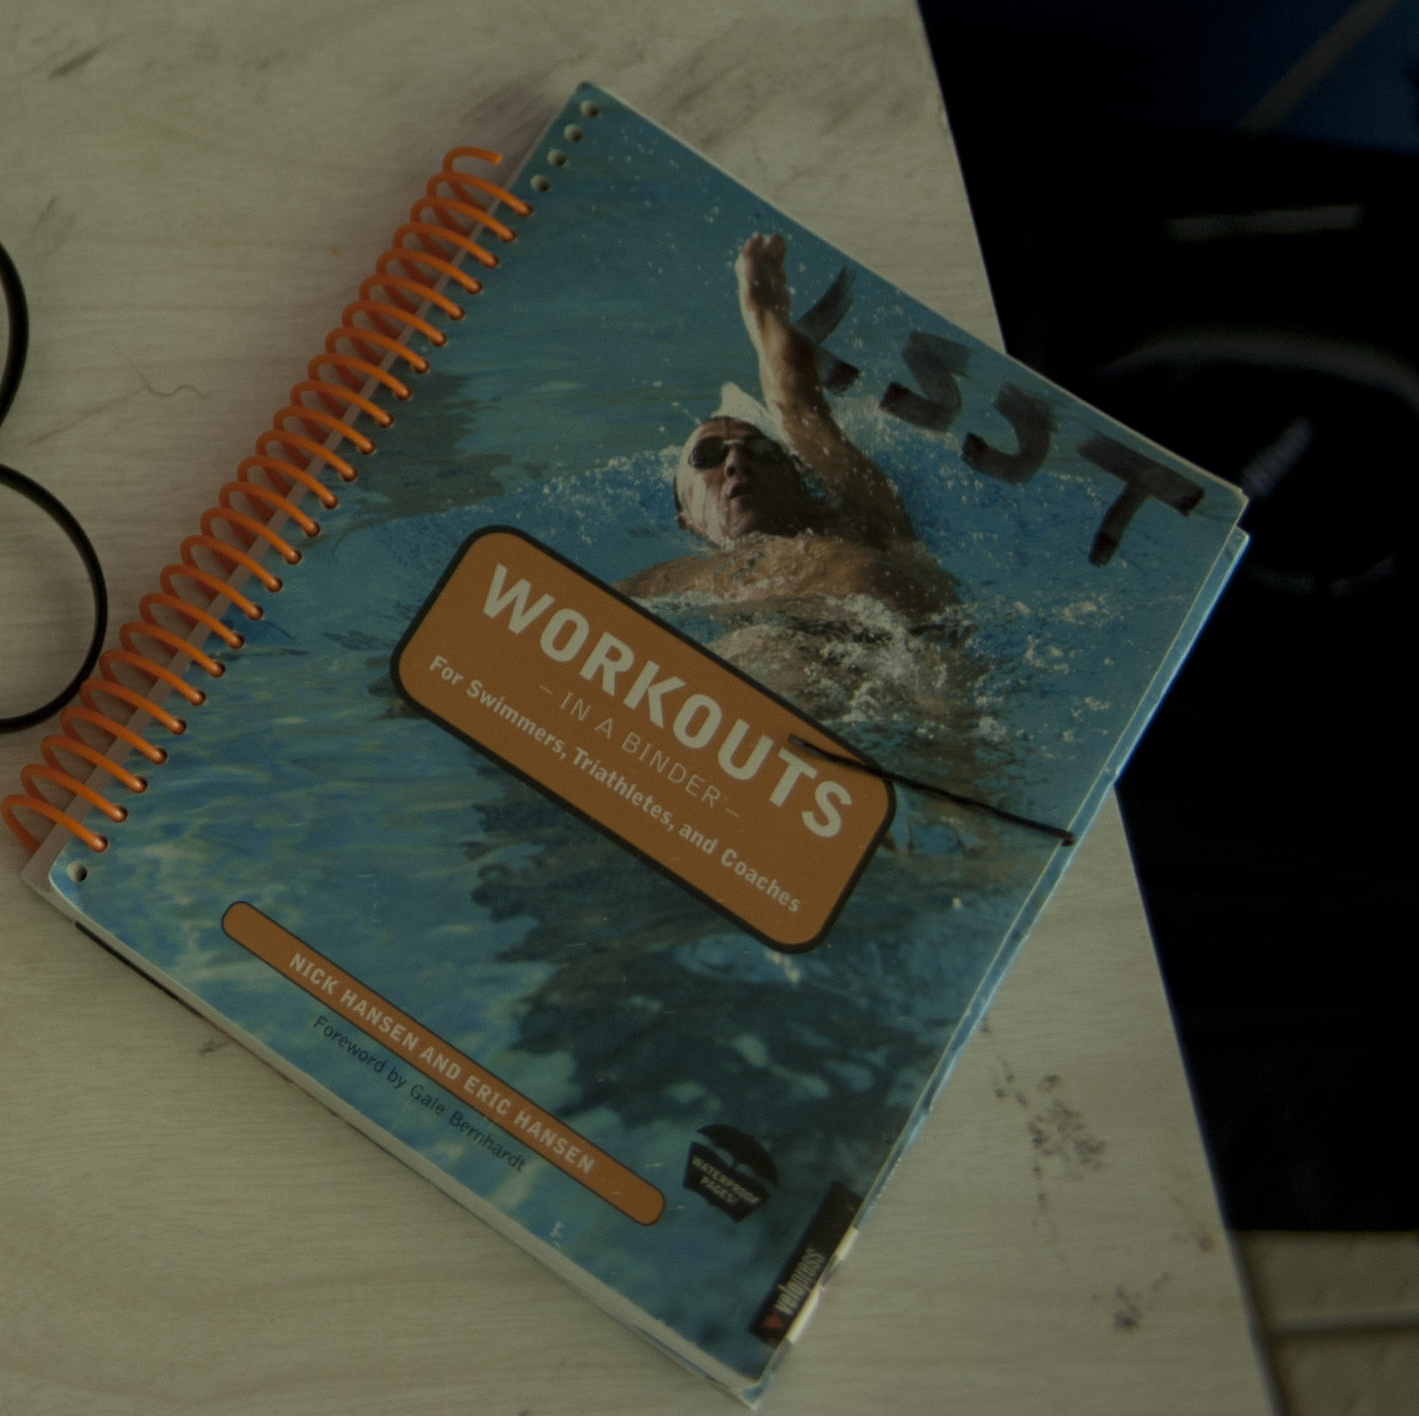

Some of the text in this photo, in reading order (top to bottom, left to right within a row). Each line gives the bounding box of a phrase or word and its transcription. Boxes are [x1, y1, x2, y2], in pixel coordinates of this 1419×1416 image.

[480, 563, 855, 840] WORKOUTS
[558, 691, 723, 808] IN A BINDER
[428, 654, 803, 915] For Swimmers, Triathletes, and Coaches
[288, 951, 598, 1176] NICK HANSEN AND ERIC HANSEN
[312, 1014, 528, 1173] Foreword by Gale Bernhardt
[691, 1156, 761, 1205] WATERPROOF
[774, 1246, 826, 1317] velopress
